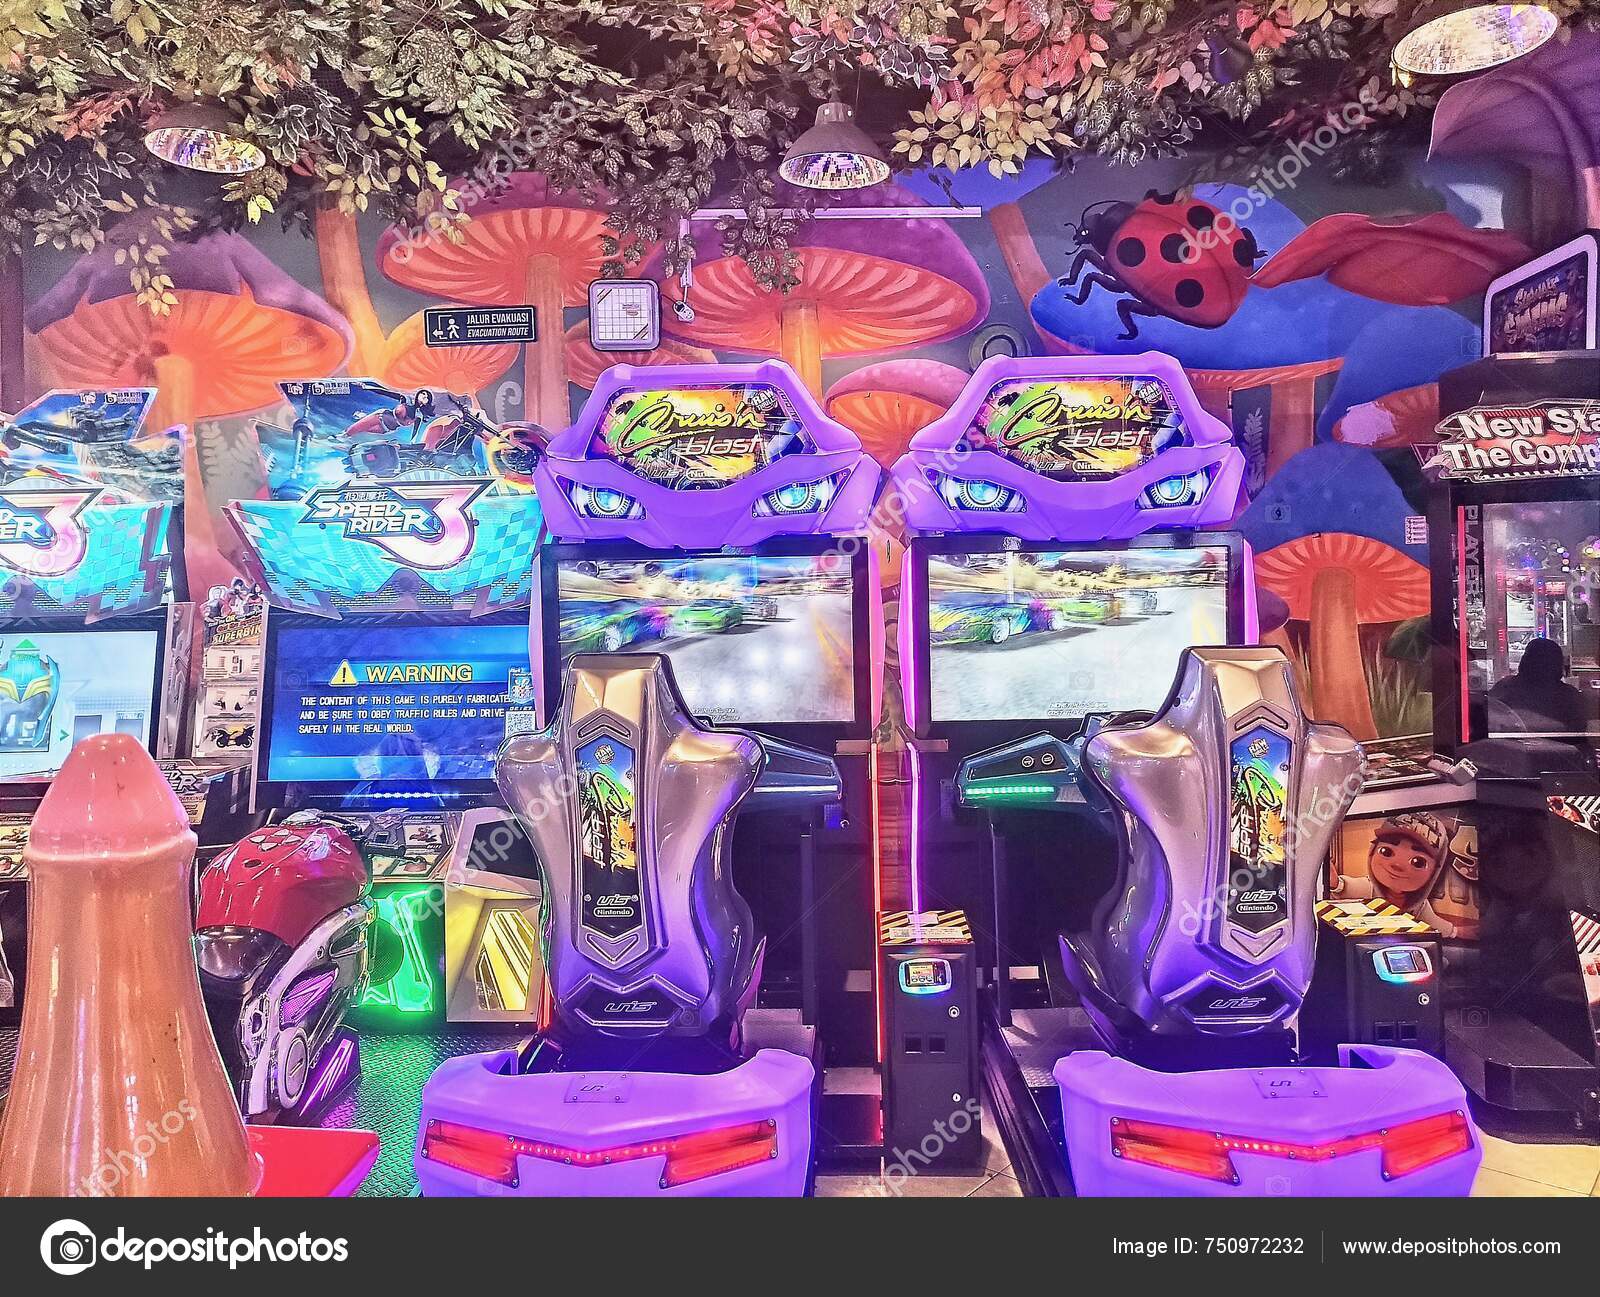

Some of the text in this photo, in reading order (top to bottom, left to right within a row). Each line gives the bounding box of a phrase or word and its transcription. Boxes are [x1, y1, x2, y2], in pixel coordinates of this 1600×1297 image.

[467, 312, 529, 325] JALUR EVAKUASI
[467, 327, 528, 338] EVACUATION ROUTE
[1458, 411, 1544, 440] New
[1062, 428, 1151, 447] blast
[1443, 443, 1511, 470] The
[312, 494, 403, 518] SPEED
[350, 507, 433, 534] RIDER
[373, 479, 496, 570] 3
[366, 664, 473, 683] WARNING
[301, 694, 516, 706] THE CONTENT OF THIS GAME IS PURELY FABRICATE
[299, 711, 316, 720] AND
[318, 711, 329, 720] BE
[332, 711, 353, 721] SURE
[358, 710, 368, 719] TO
[371, 710, 391, 719] OBEY
[395, 709, 429, 718] TRAFFIC
[433, 709, 457, 718] RULES
[461, 709, 477, 717] AND
[480, 708, 505, 717] DRIVE
[299, 724, 414, 734] SAFELY IN THE REAL WORLD.
[596, 908, 632, 916] Nintendo
[1239, 904, 1275, 912] Nintendo
